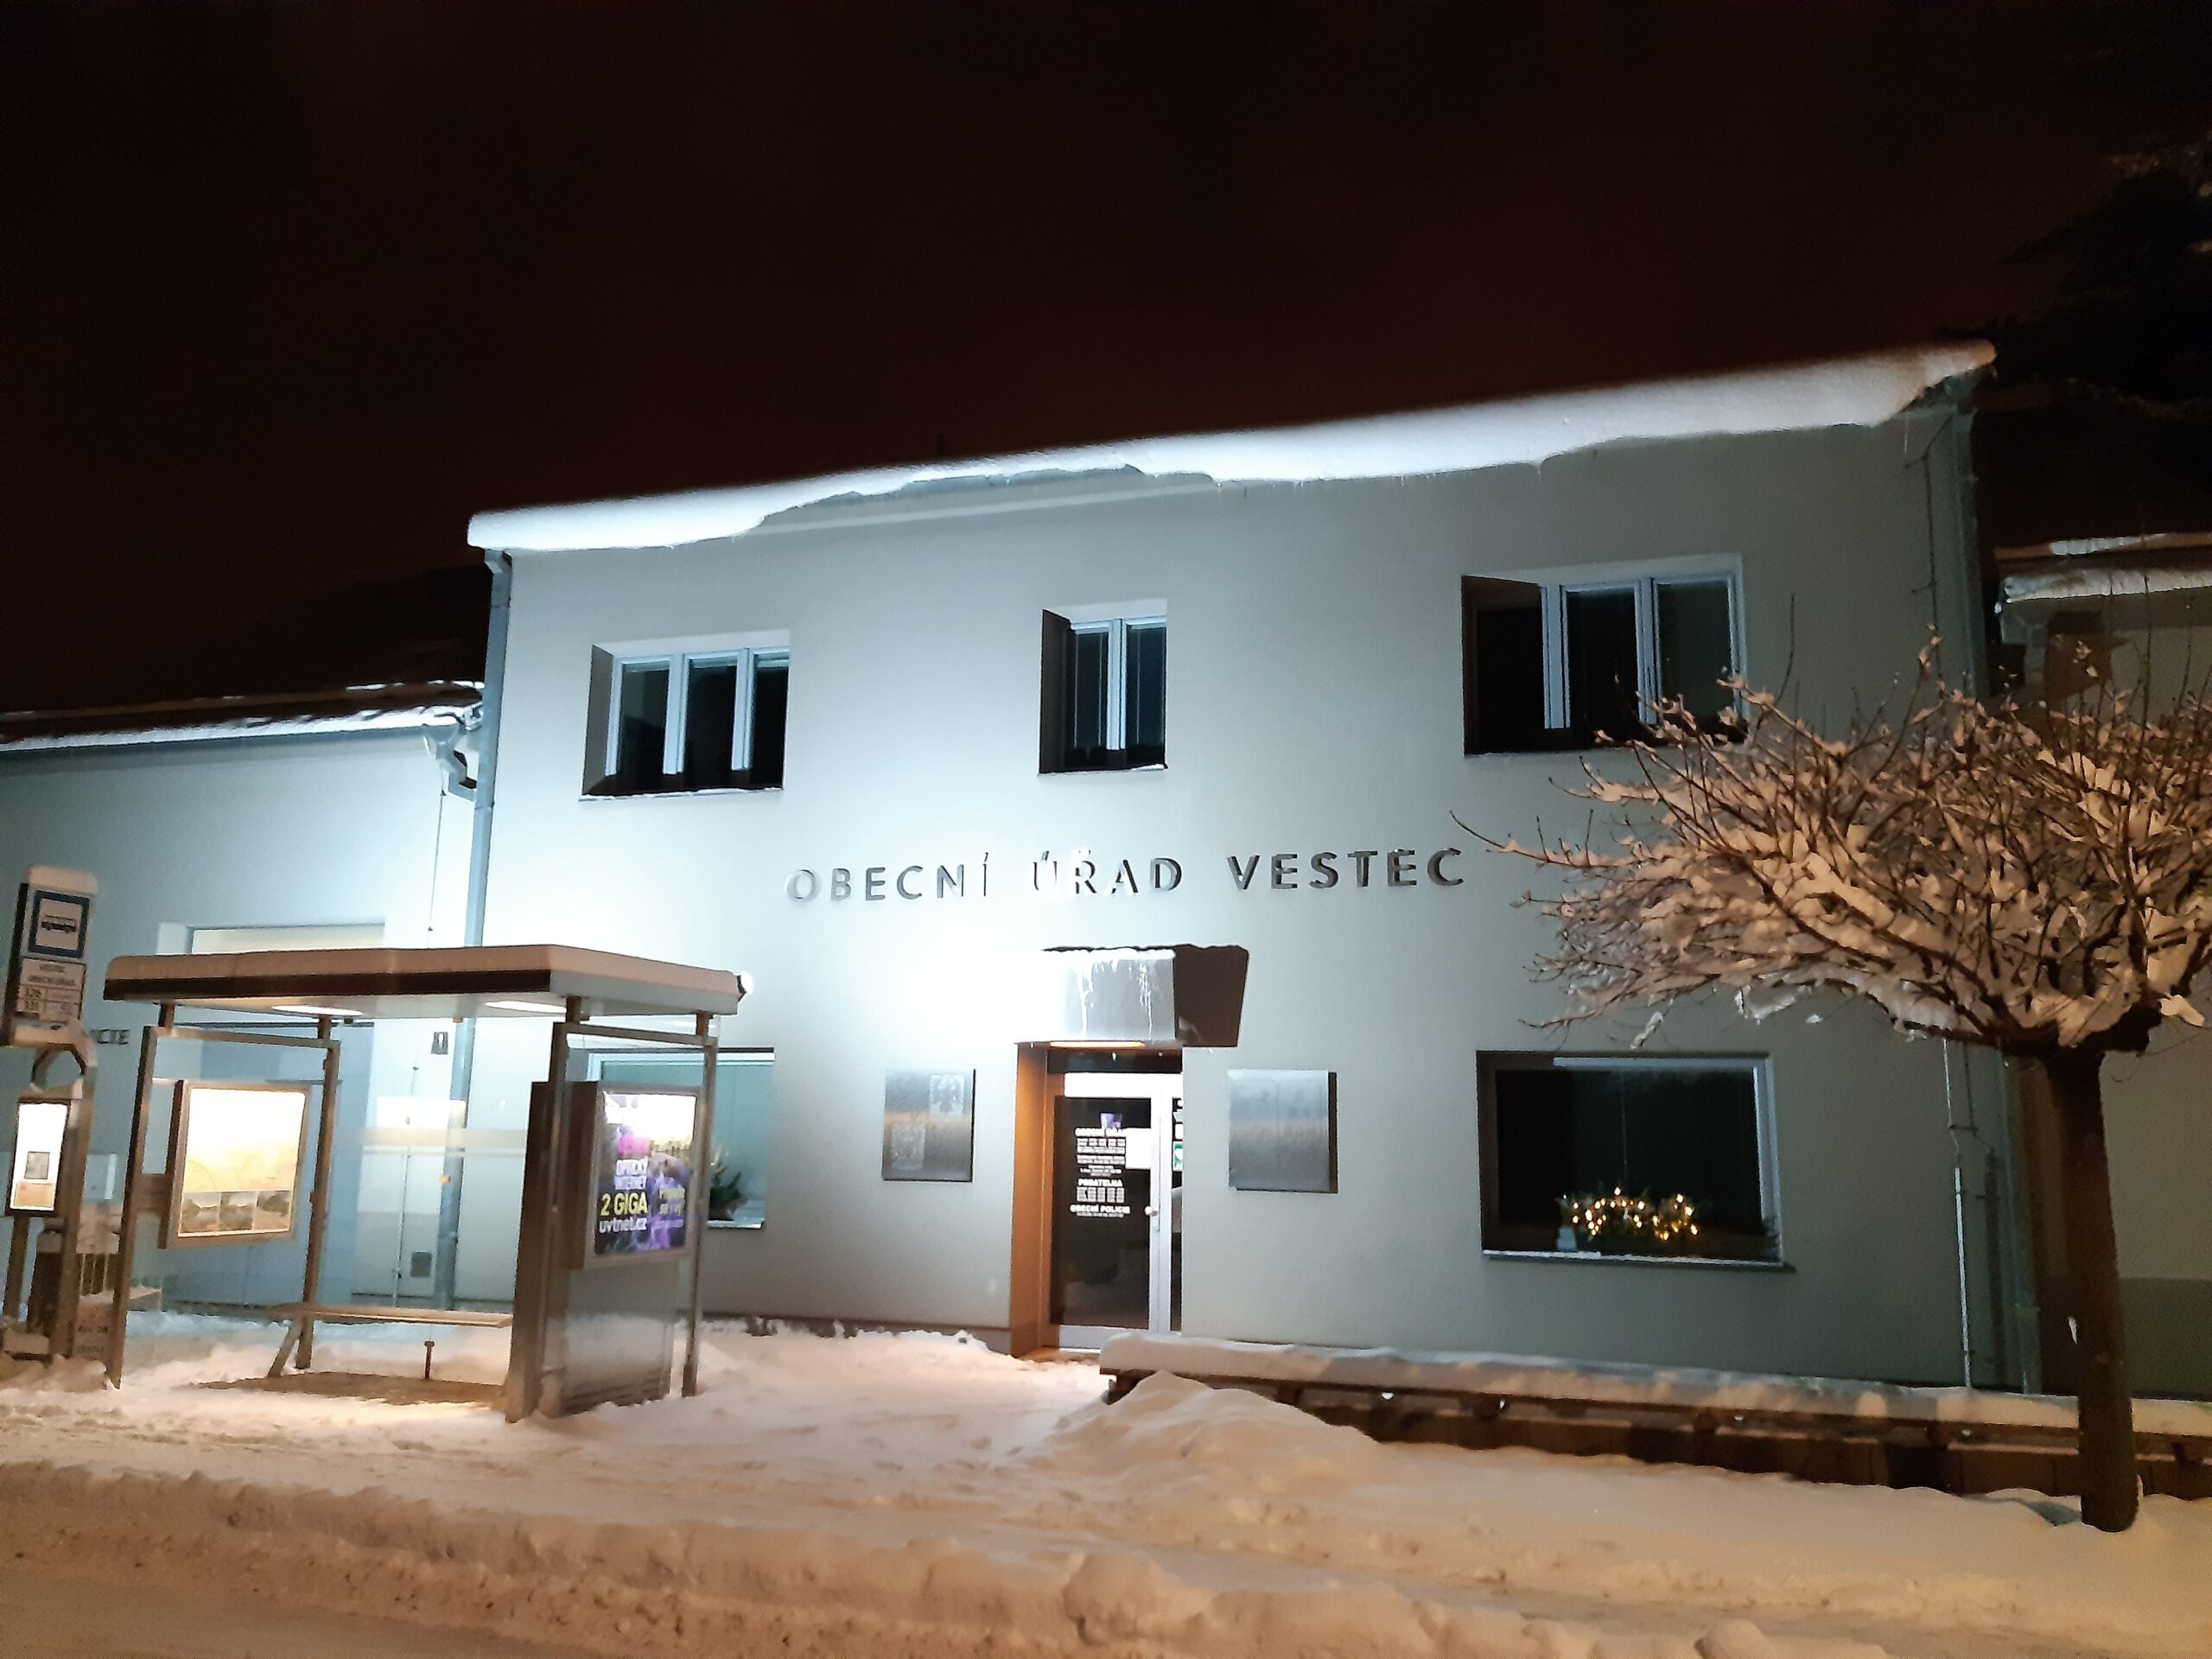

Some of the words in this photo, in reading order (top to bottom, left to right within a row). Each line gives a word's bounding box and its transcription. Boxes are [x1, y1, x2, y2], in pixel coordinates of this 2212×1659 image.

[786, 852, 989, 901] OBECNÍ
[1033, 849, 1182, 895] ÚŘAD
[1226, 848, 1465, 891] VESTEC
[600, 1192, 612, 1217] 2
[613, 1192, 648, 1216] GIGA
